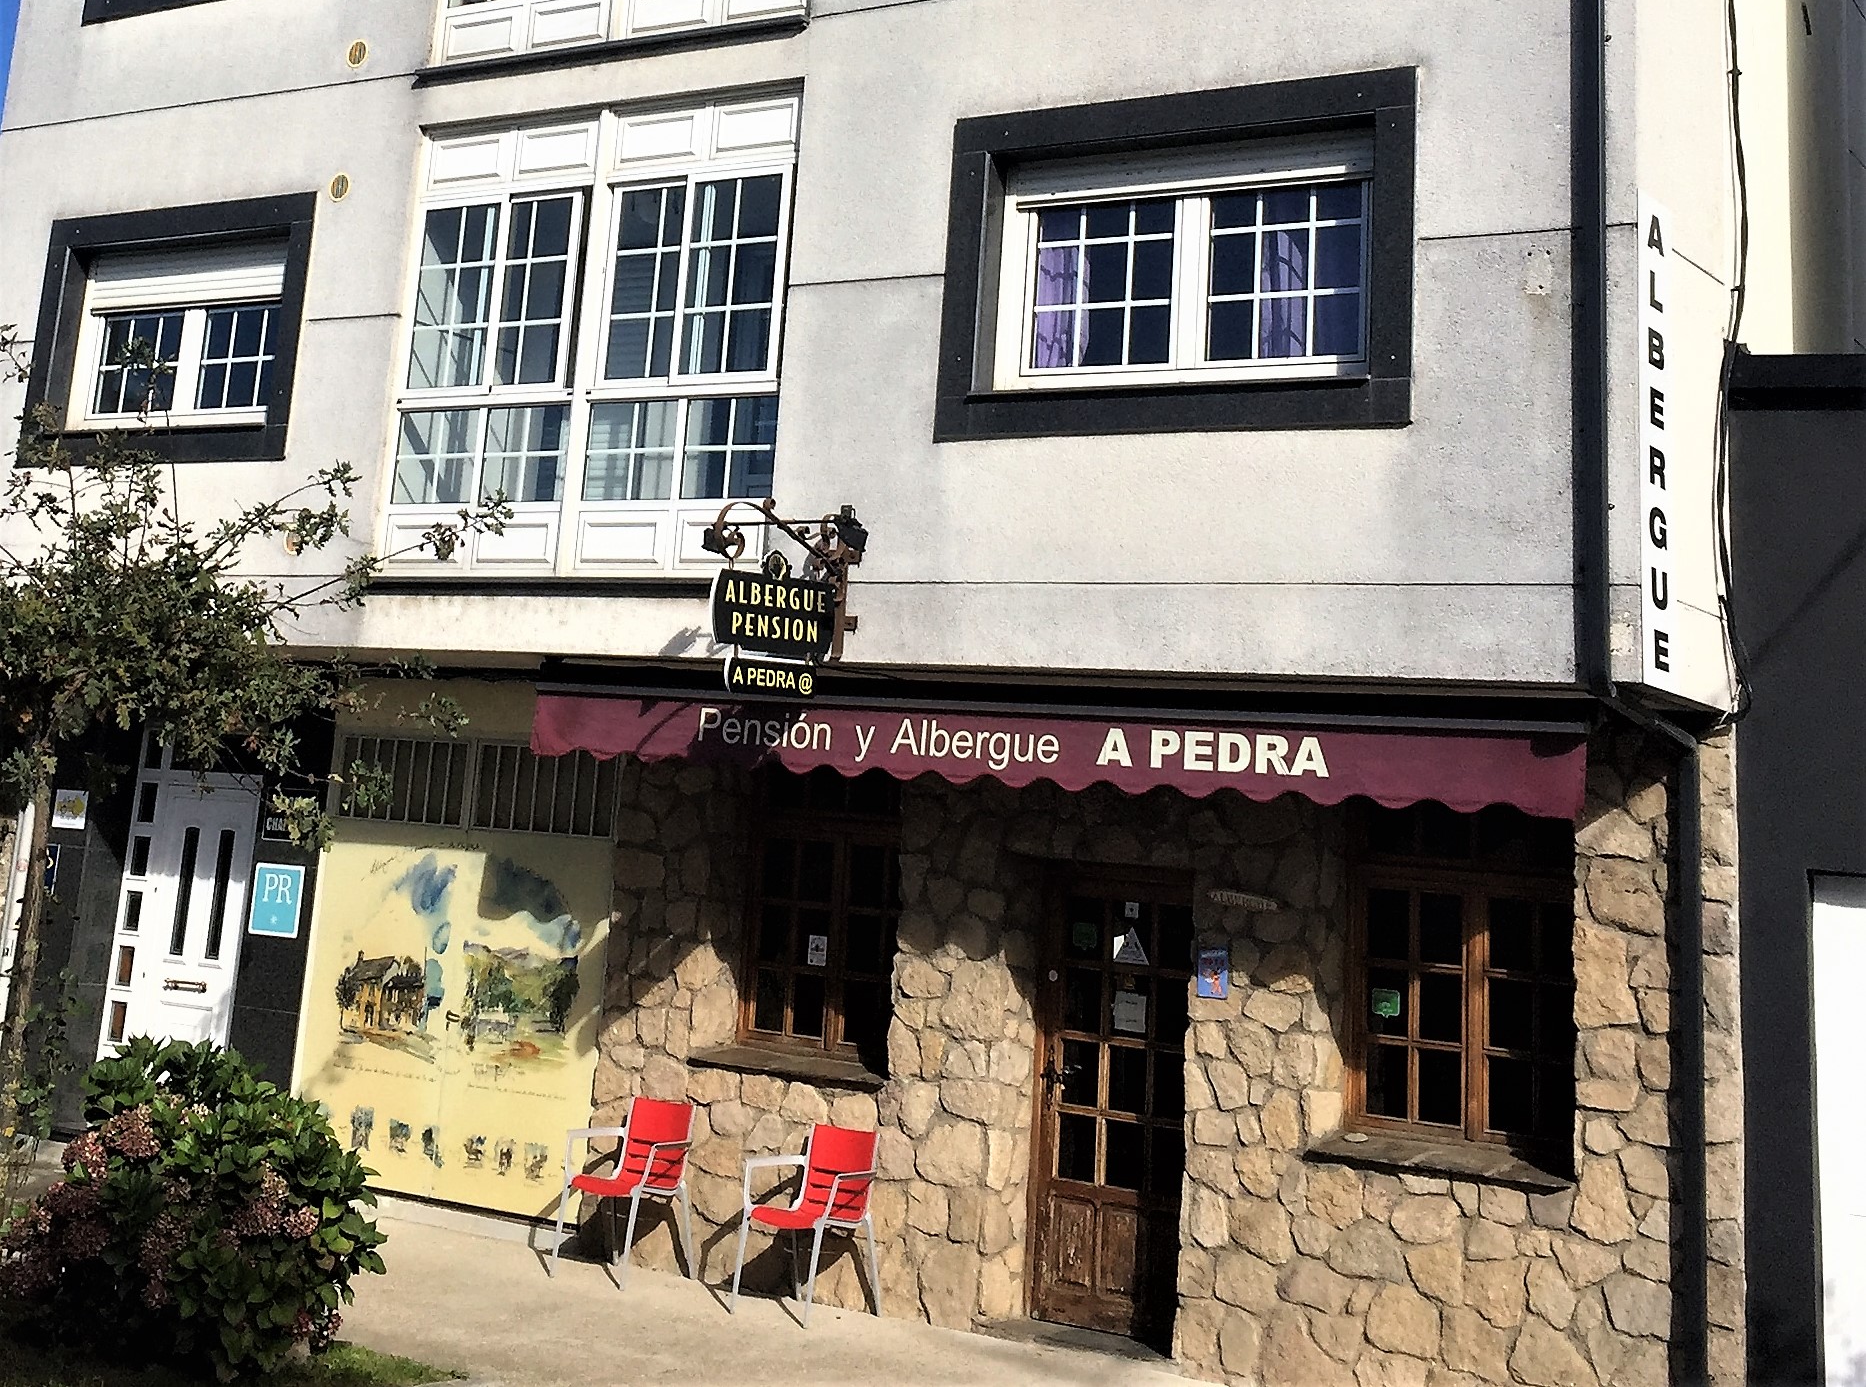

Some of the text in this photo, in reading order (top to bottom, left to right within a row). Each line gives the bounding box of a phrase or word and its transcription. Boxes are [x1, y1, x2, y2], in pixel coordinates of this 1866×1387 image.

[1647, 214, 1670, 672] ALBERGUE
[725, 579, 826, 613] ALBERGUE
[731, 611, 818, 643] PENSION
[732, 665, 744, 685] A
[747, 667, 796, 690] PEDRA
[698, 707, 1330, 778] Pensión y Albergue A PEDRA
[262, 873, 292, 905] PR
